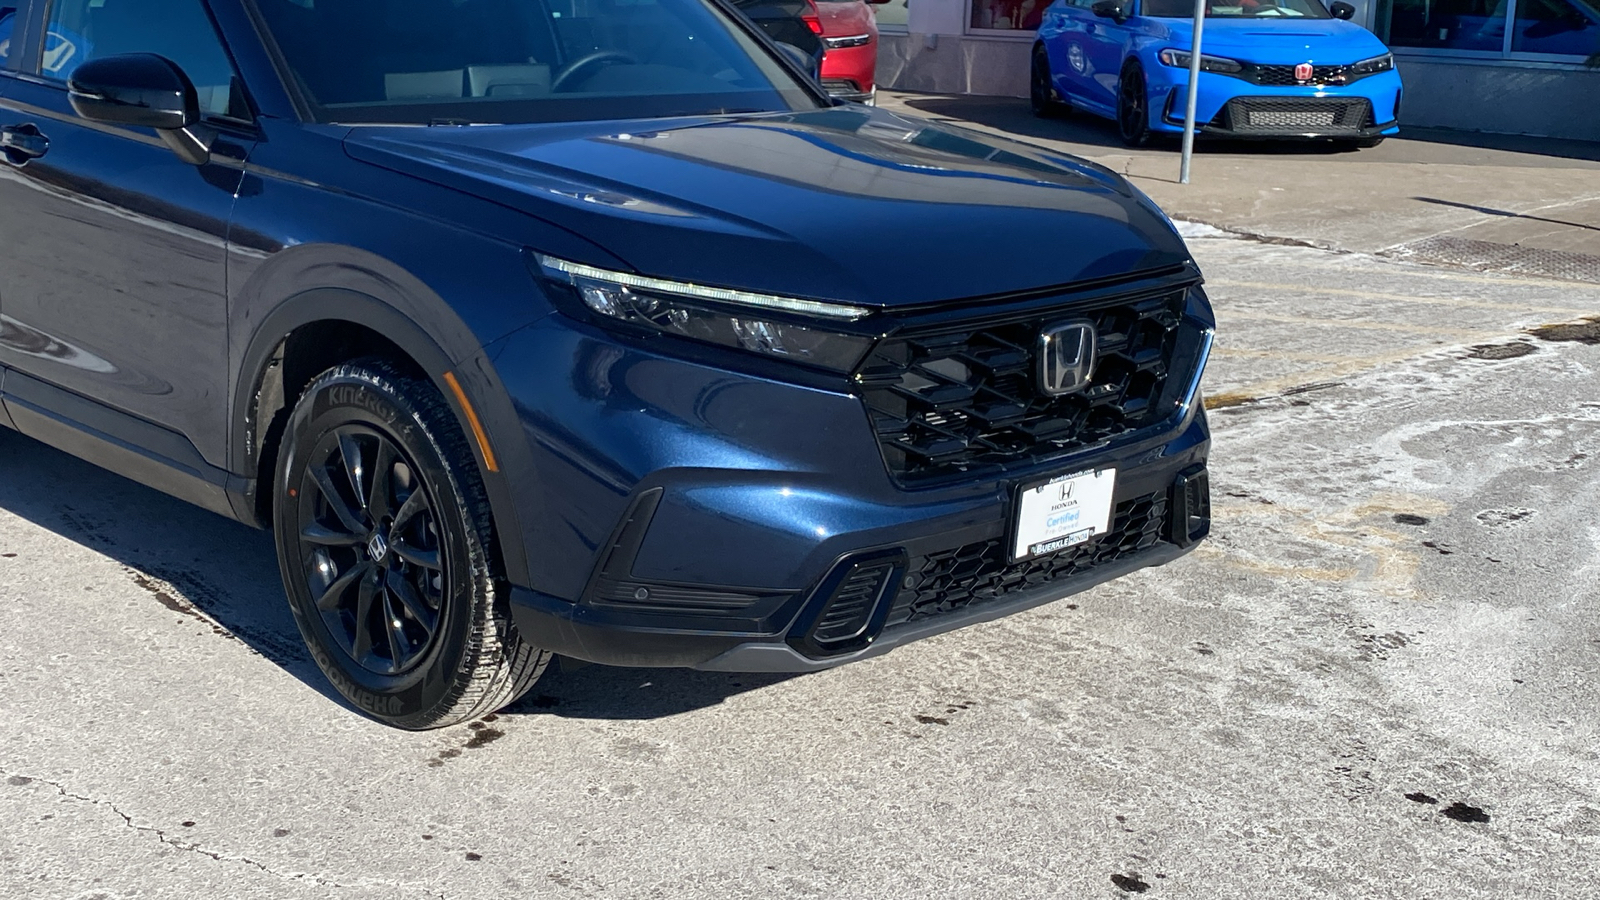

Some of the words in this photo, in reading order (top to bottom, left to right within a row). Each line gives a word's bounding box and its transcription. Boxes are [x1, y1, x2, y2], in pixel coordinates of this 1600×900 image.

[1051, 499, 1078, 511] HONDA
[1047, 510, 1080, 527] Certified
[1069, 533, 1088, 544] HONDA
